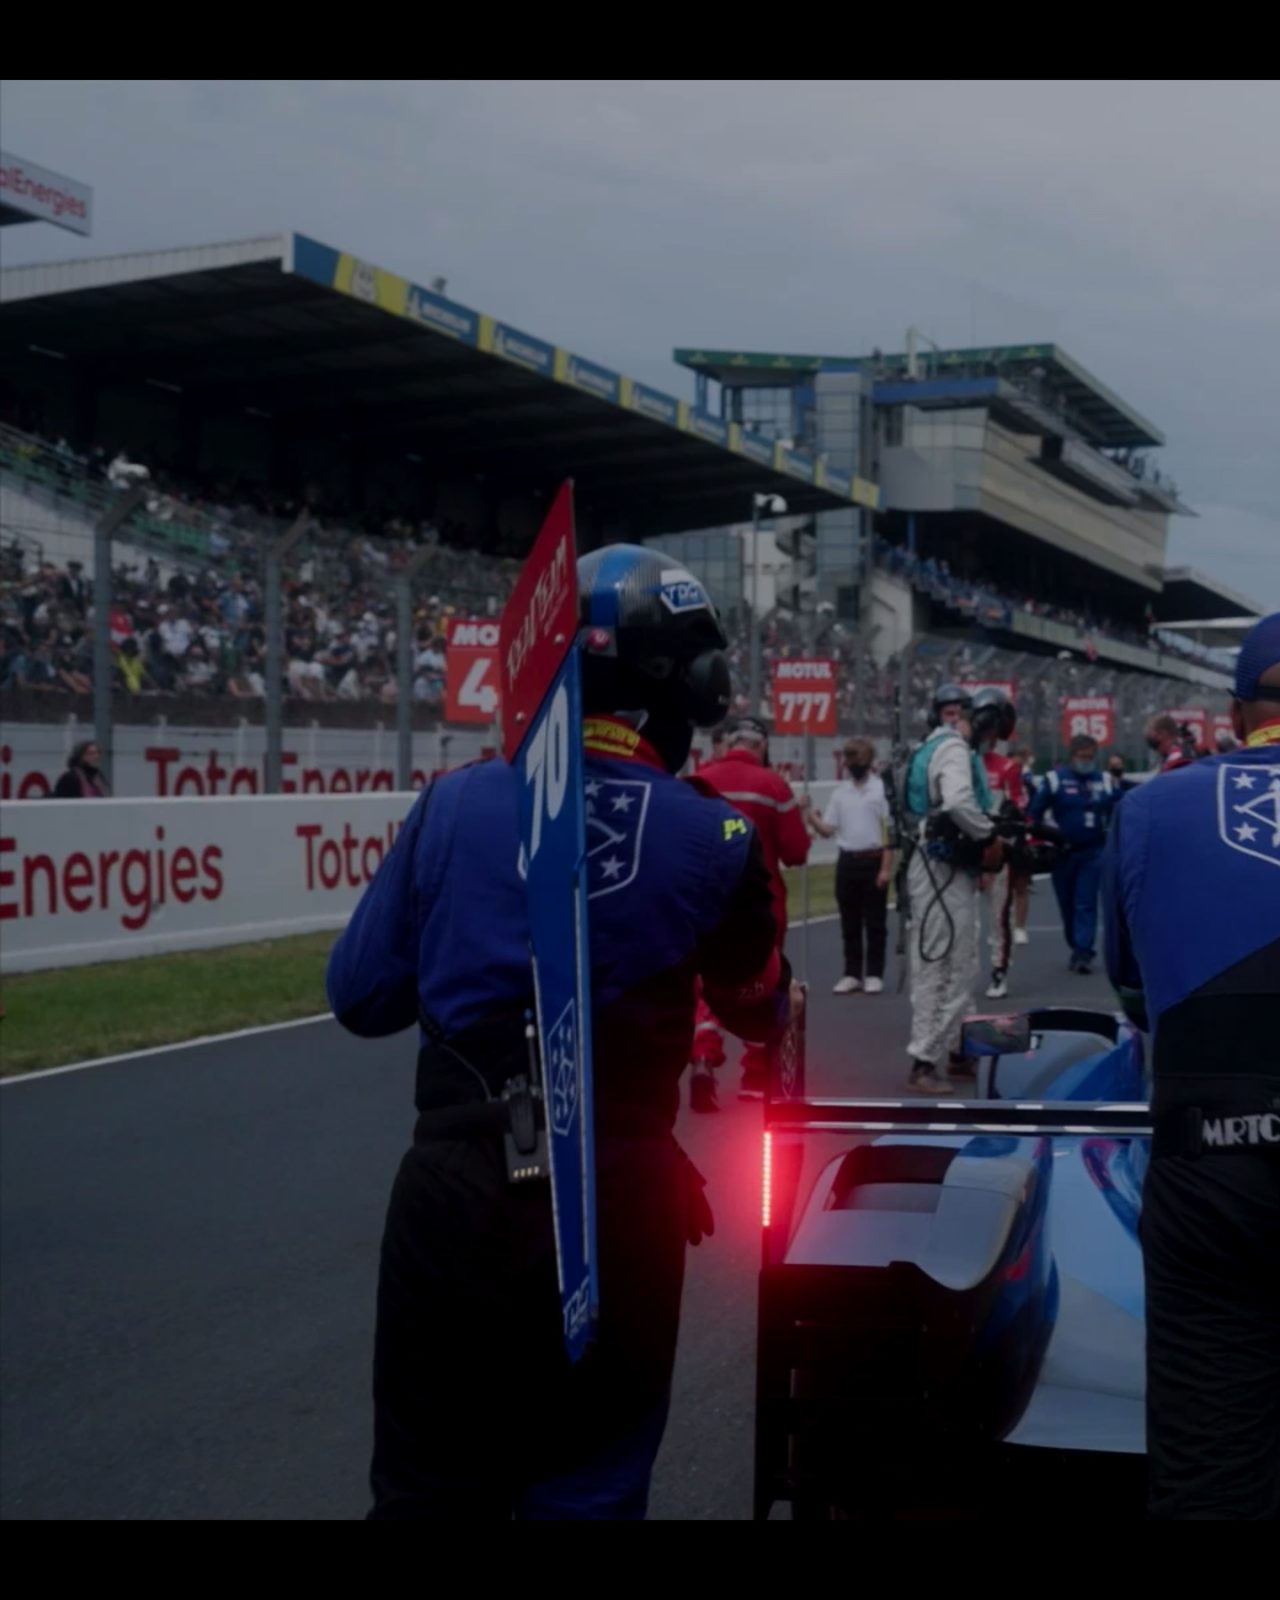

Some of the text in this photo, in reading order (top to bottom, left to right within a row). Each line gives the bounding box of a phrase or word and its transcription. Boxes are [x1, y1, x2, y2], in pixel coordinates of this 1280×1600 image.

[451, 623, 501, 647] MO
[777, 661, 833, 679] MOTUL
[778, 691, 831, 723] 777
[1070, 714, 1108, 743] 85
